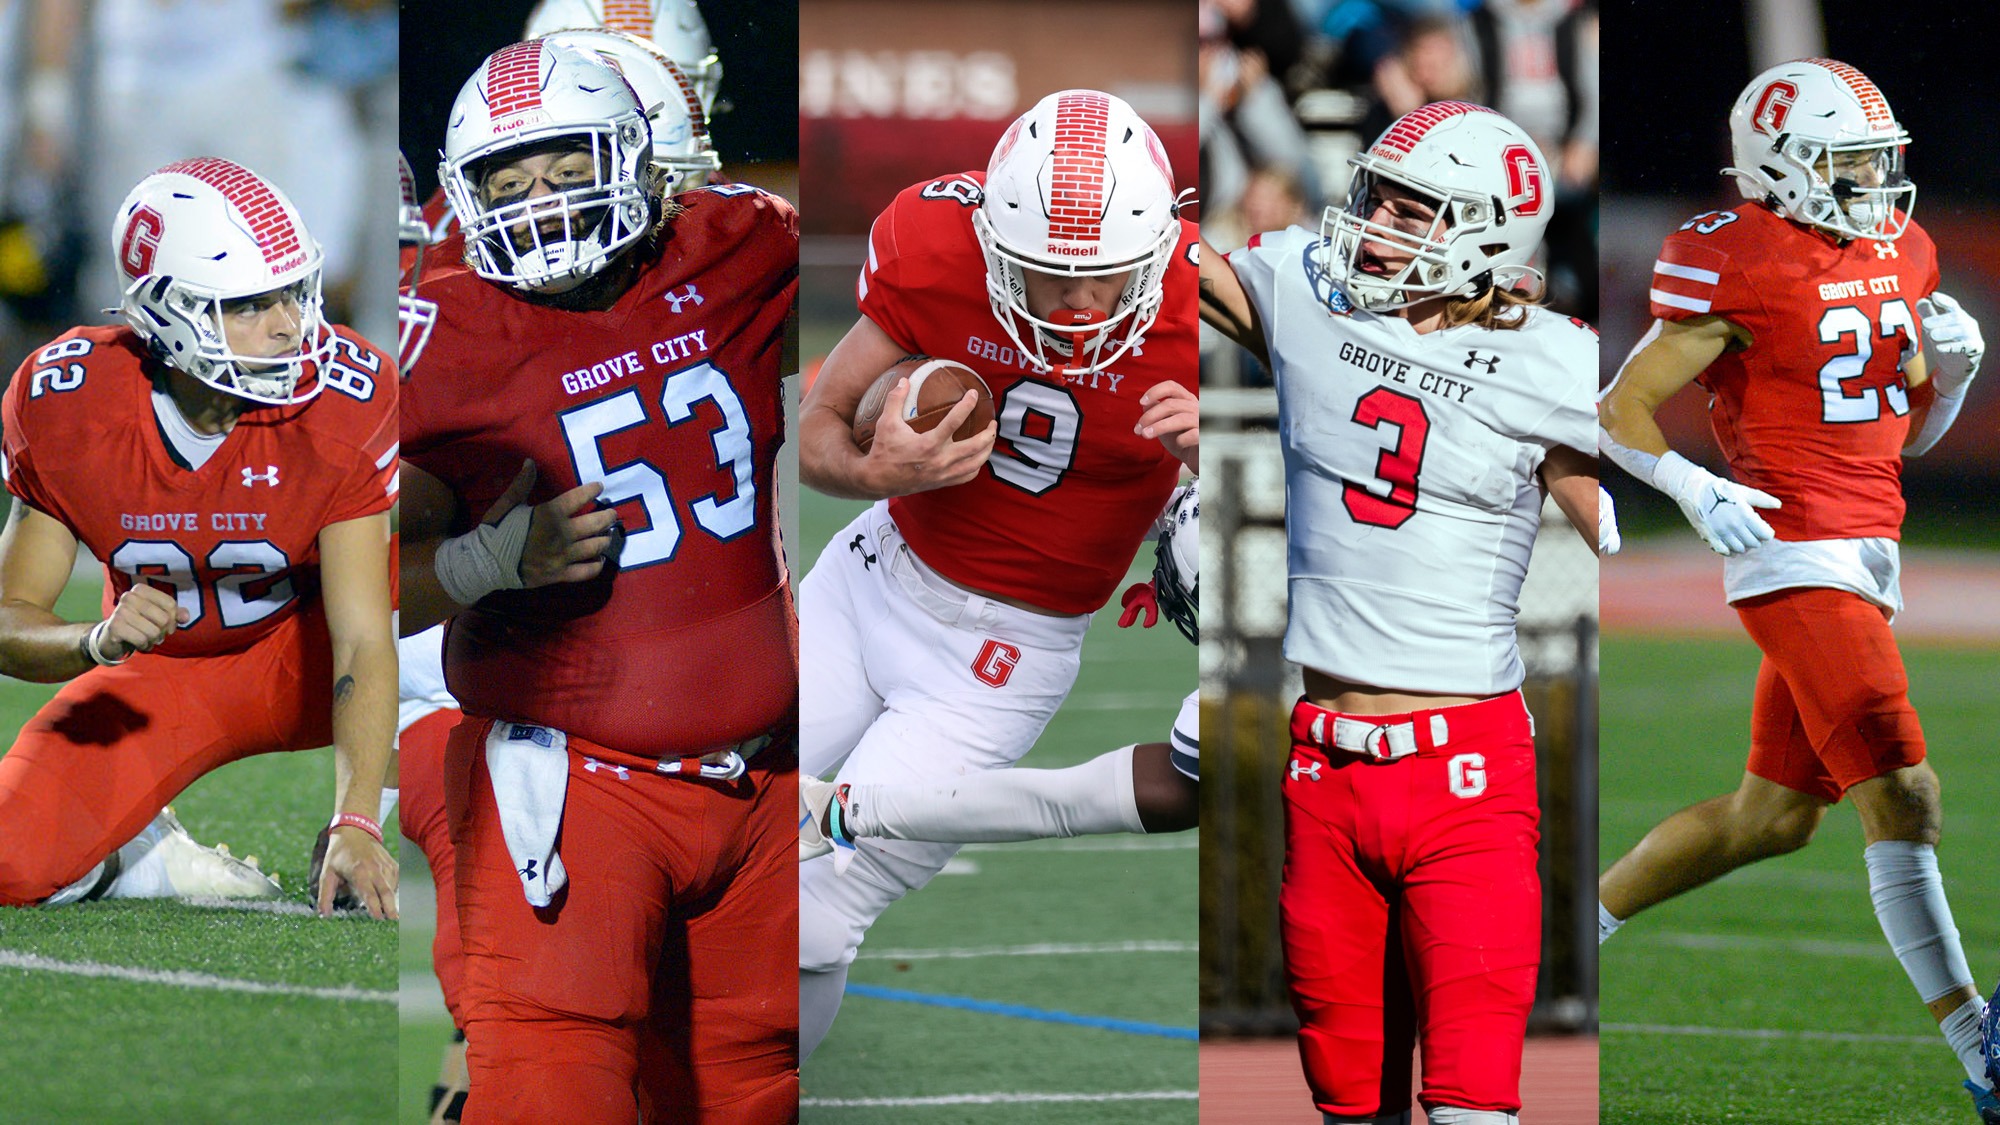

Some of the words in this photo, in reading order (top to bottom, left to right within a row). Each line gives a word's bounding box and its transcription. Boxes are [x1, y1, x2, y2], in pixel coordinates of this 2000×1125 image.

[1752, 79, 1799, 134] G
[1371, 145, 1402, 163] Riddell
[1501, 144, 1544, 217] G
[121, 204, 166, 280] G
[1047, 243, 1098, 256] Riddell
[1818, 279, 1867, 301] GROVE
[1869, 275, 1900, 295] CITY
[29, 337, 95, 400] 82
[325, 334, 382, 403] 82
[561, 350, 645, 395] GROVE
[652, 329, 709, 365] CITY
[967, 336, 1049, 376] GROVE
[1339, 341, 1411, 384] GROVE
[1420, 372, 1474, 402] CITY
[1818, 297, 1918, 424] 23
[556, 358, 758, 572] 53
[985, 376, 1084, 497] 9
[1341, 384, 1431, 530] 3
[120, 513, 199, 532] GROVE
[211, 513, 267, 531] CITY
[970, 638, 1022, 689] G
[1447, 752, 1487, 799] G
